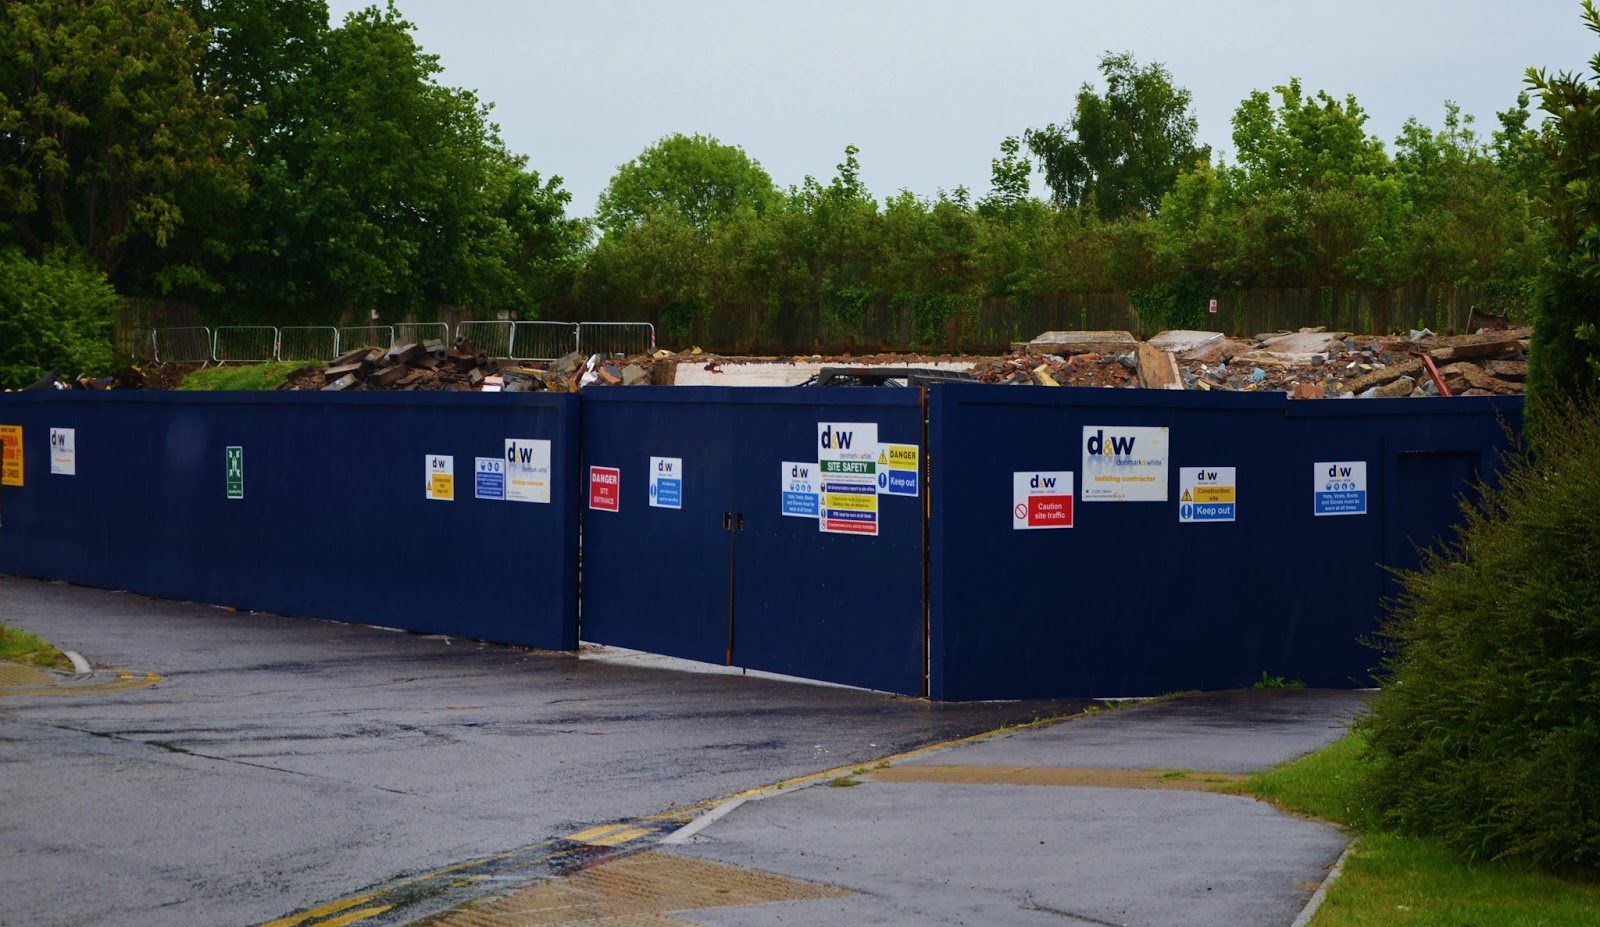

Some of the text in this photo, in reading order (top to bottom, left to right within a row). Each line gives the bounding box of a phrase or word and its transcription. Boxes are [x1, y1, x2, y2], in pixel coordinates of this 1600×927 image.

[1087, 429, 1135, 456] d&w
[890, 450, 916, 460] DANGER
[827, 462, 868, 472] SITE SAFETY
[592, 472, 617, 484] DANGER
[890, 477, 916, 488] Keep out
[594, 496, 614, 505] ENTRANCE
[1196, 506, 1216, 516] Keep
